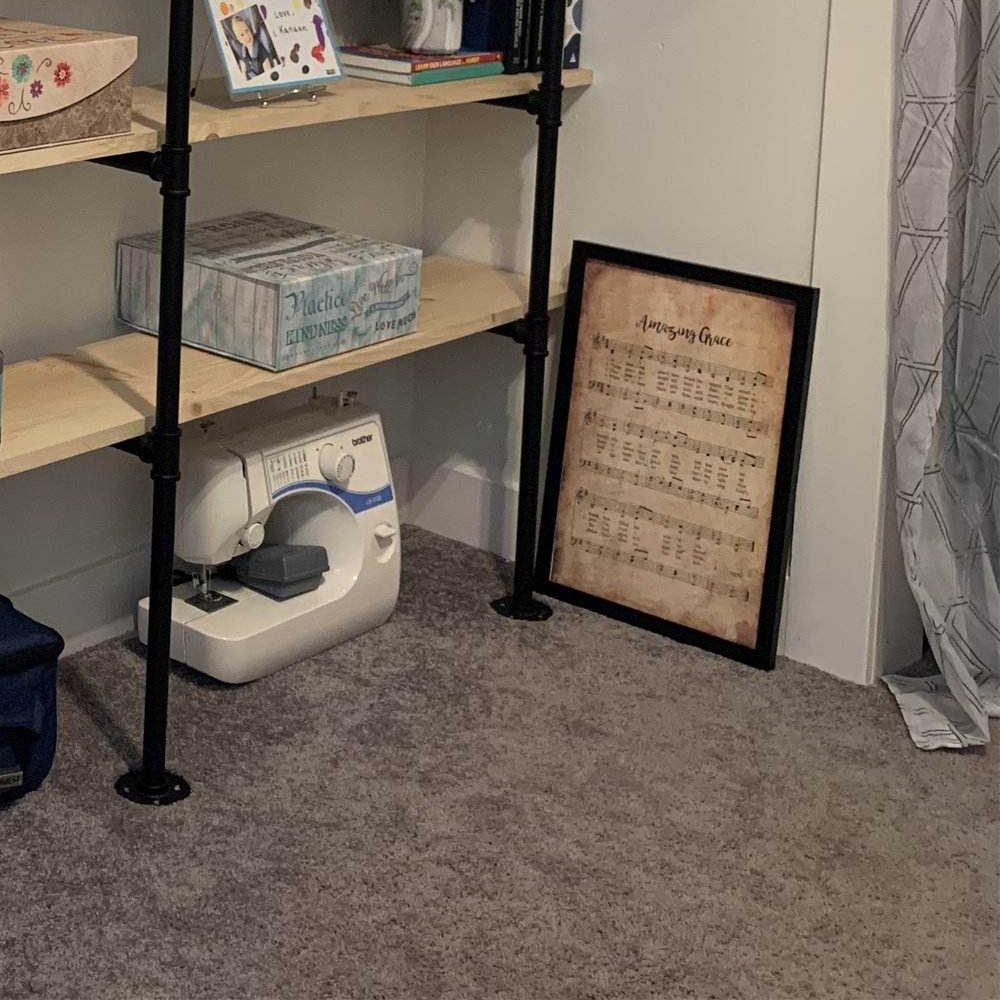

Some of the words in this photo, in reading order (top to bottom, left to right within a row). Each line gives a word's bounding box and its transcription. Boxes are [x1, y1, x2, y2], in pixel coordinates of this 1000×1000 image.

[284, 289, 347, 321] Practice
[285, 315, 348, 346] KINDNESS
[375, 319, 397, 331] LOVE
[635, 314, 696, 345] Amazing
[698, 326, 732, 348] Grace
[351, 433, 373, 447] brother
